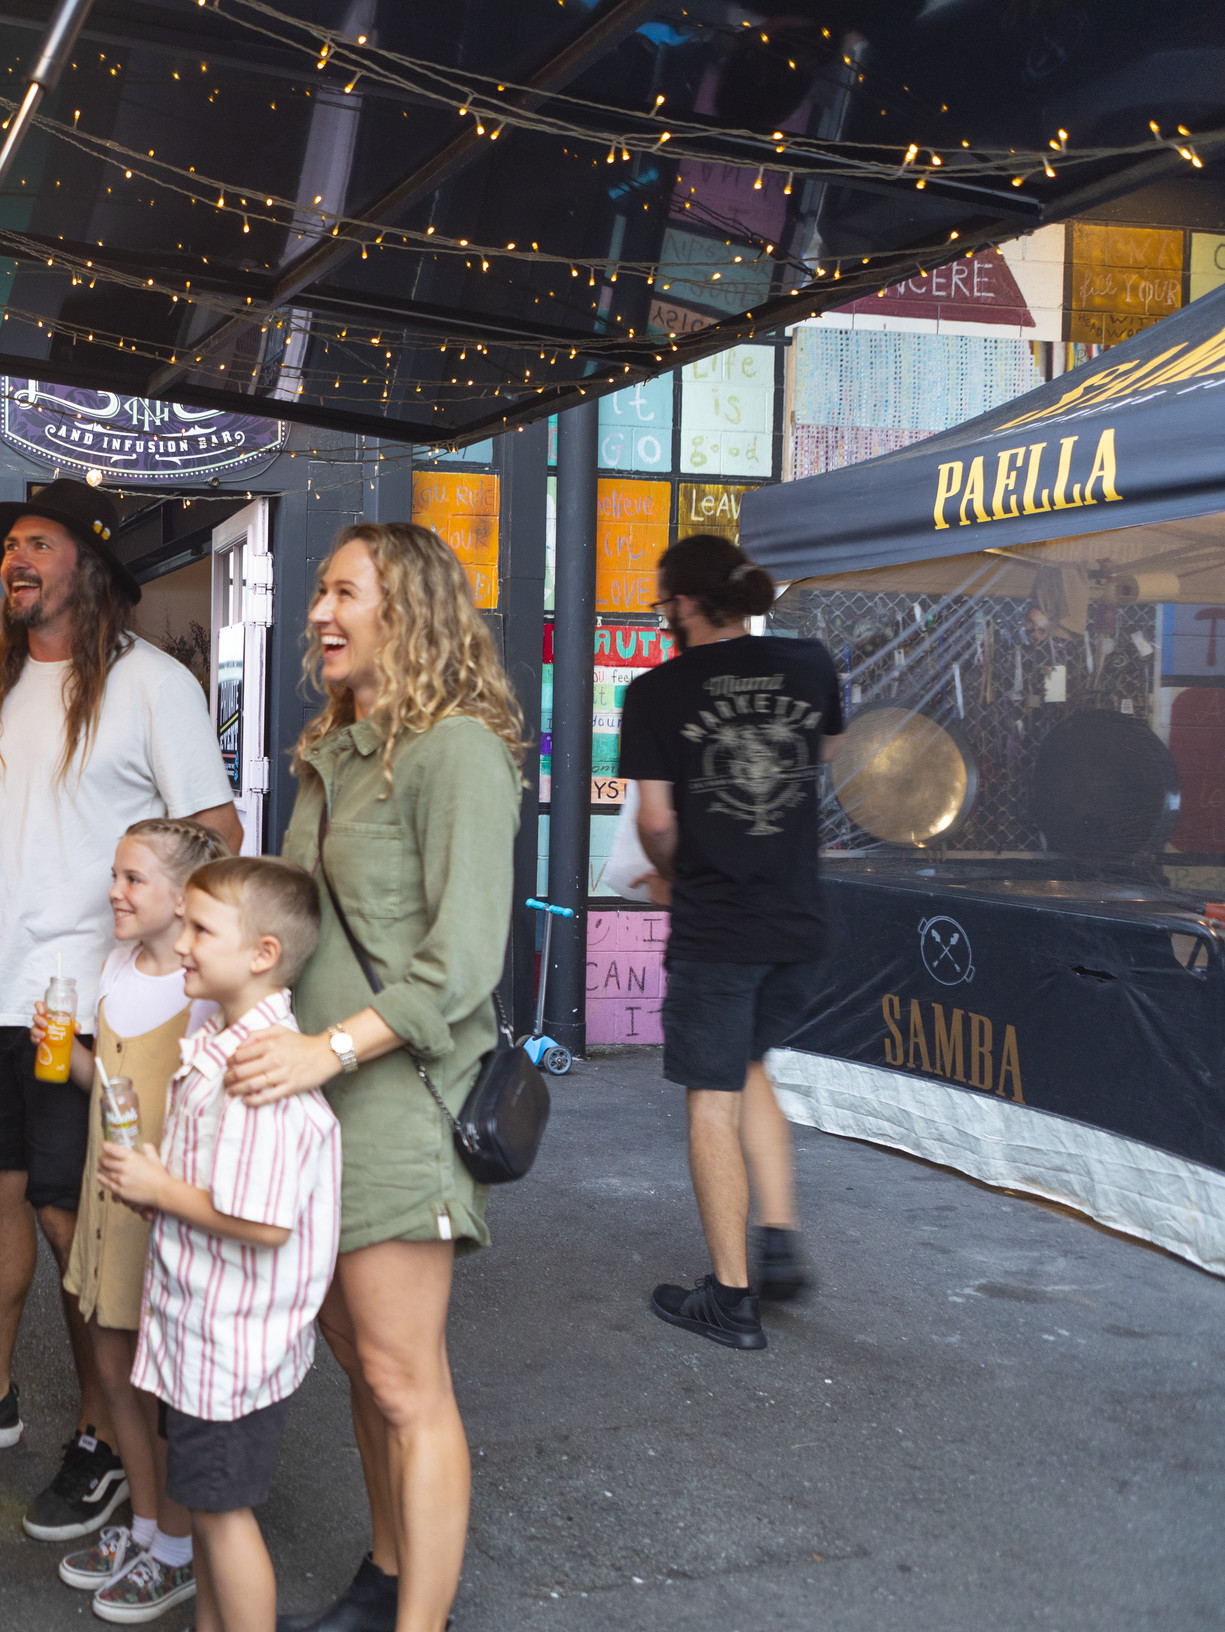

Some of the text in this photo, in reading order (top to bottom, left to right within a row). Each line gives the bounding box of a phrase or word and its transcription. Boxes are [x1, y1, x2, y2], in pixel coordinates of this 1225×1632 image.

[1122, 273, 1181, 309] YOUR
[57, 425, 232, 453] AND INFUSION BAR
[601, 432, 662, 467] GO
[690, 435, 760, 468] good
[933, 428, 1124, 530] PAELLA
[597, 578, 651, 609] OVE
[595, 629, 675, 663] AUTY
[882, 993, 1026, 1105] SAMBA
